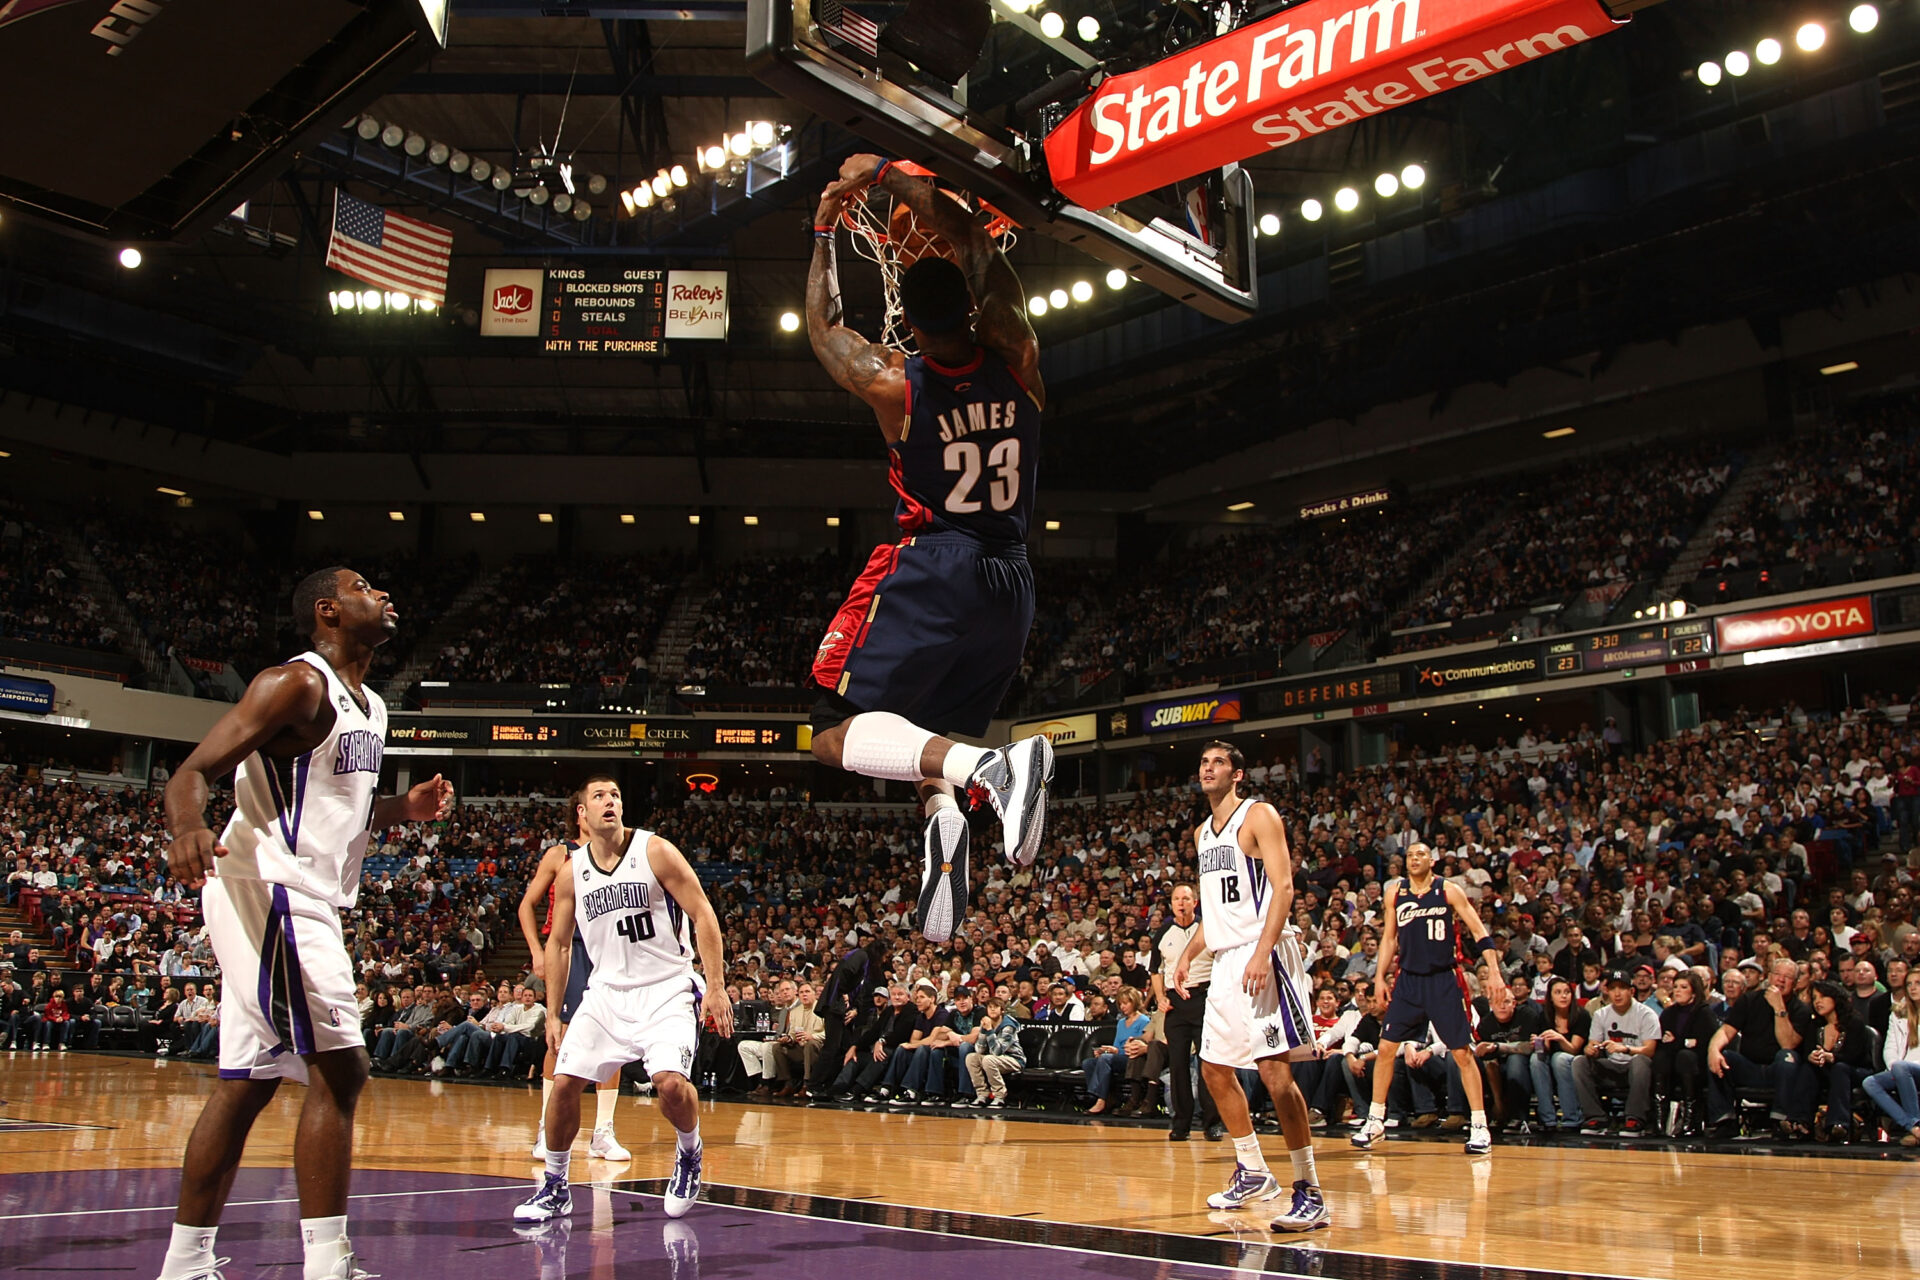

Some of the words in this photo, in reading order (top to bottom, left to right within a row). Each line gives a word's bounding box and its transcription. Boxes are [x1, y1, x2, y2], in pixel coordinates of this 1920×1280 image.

[1090, 61, 1239, 164] State
[1247, 0, 1420, 103] Farm
[1252, 82, 1416, 147] State
[1406, 25, 1590, 93] Farm
[549, 270, 585, 279] KINGS
[624, 270, 662, 280] GUEST
[566, 283, 610, 293] BLOCKED
[612, 284, 644, 293] SHOTS
[493, 288, 531, 311] Jack
[553, 297, 562, 307] 4
[574, 297, 635, 308] REBOUNDS
[654, 297, 662, 308] 5
[671, 284, 724, 305] Raley's
[581, 312, 626, 322] STEALS
[586, 326, 619, 336] TOTAL
[578, 340, 598, 352] THE
[604, 341, 658, 352] PURCHASE
[936, 400, 1017, 443] JAMES
[943, 437, 1021, 514] 23
[1300, 503, 1337, 519] Snacks
[1339, 499, 1349, 510] &
[1351, 491, 1389, 507] Drinks
[1762, 607, 1864, 637] TOYOTA
[1551, 643, 1575, 653] HOME
[1674, 624, 1704, 636] GUEST
[1591, 634, 1619, 650] 3:30
[1557, 657, 1574, 671] 23
[1684, 640, 1701, 653] 22
[1679, 661, 1697, 672] 103
[1445, 657, 1536, 682] Communications
[1284, 679, 1373, 706] DEFENSE
[1151, 700, 1220, 728] SUBWAY
[583, 728, 627, 738] CACHE
[647, 729, 691, 739] CREEK
[583, 882, 650, 922] SACRAMENTO
[1221, 875, 1240, 904] 18
[616, 911, 656, 943] 40
[1426, 918, 1446, 941] 18
